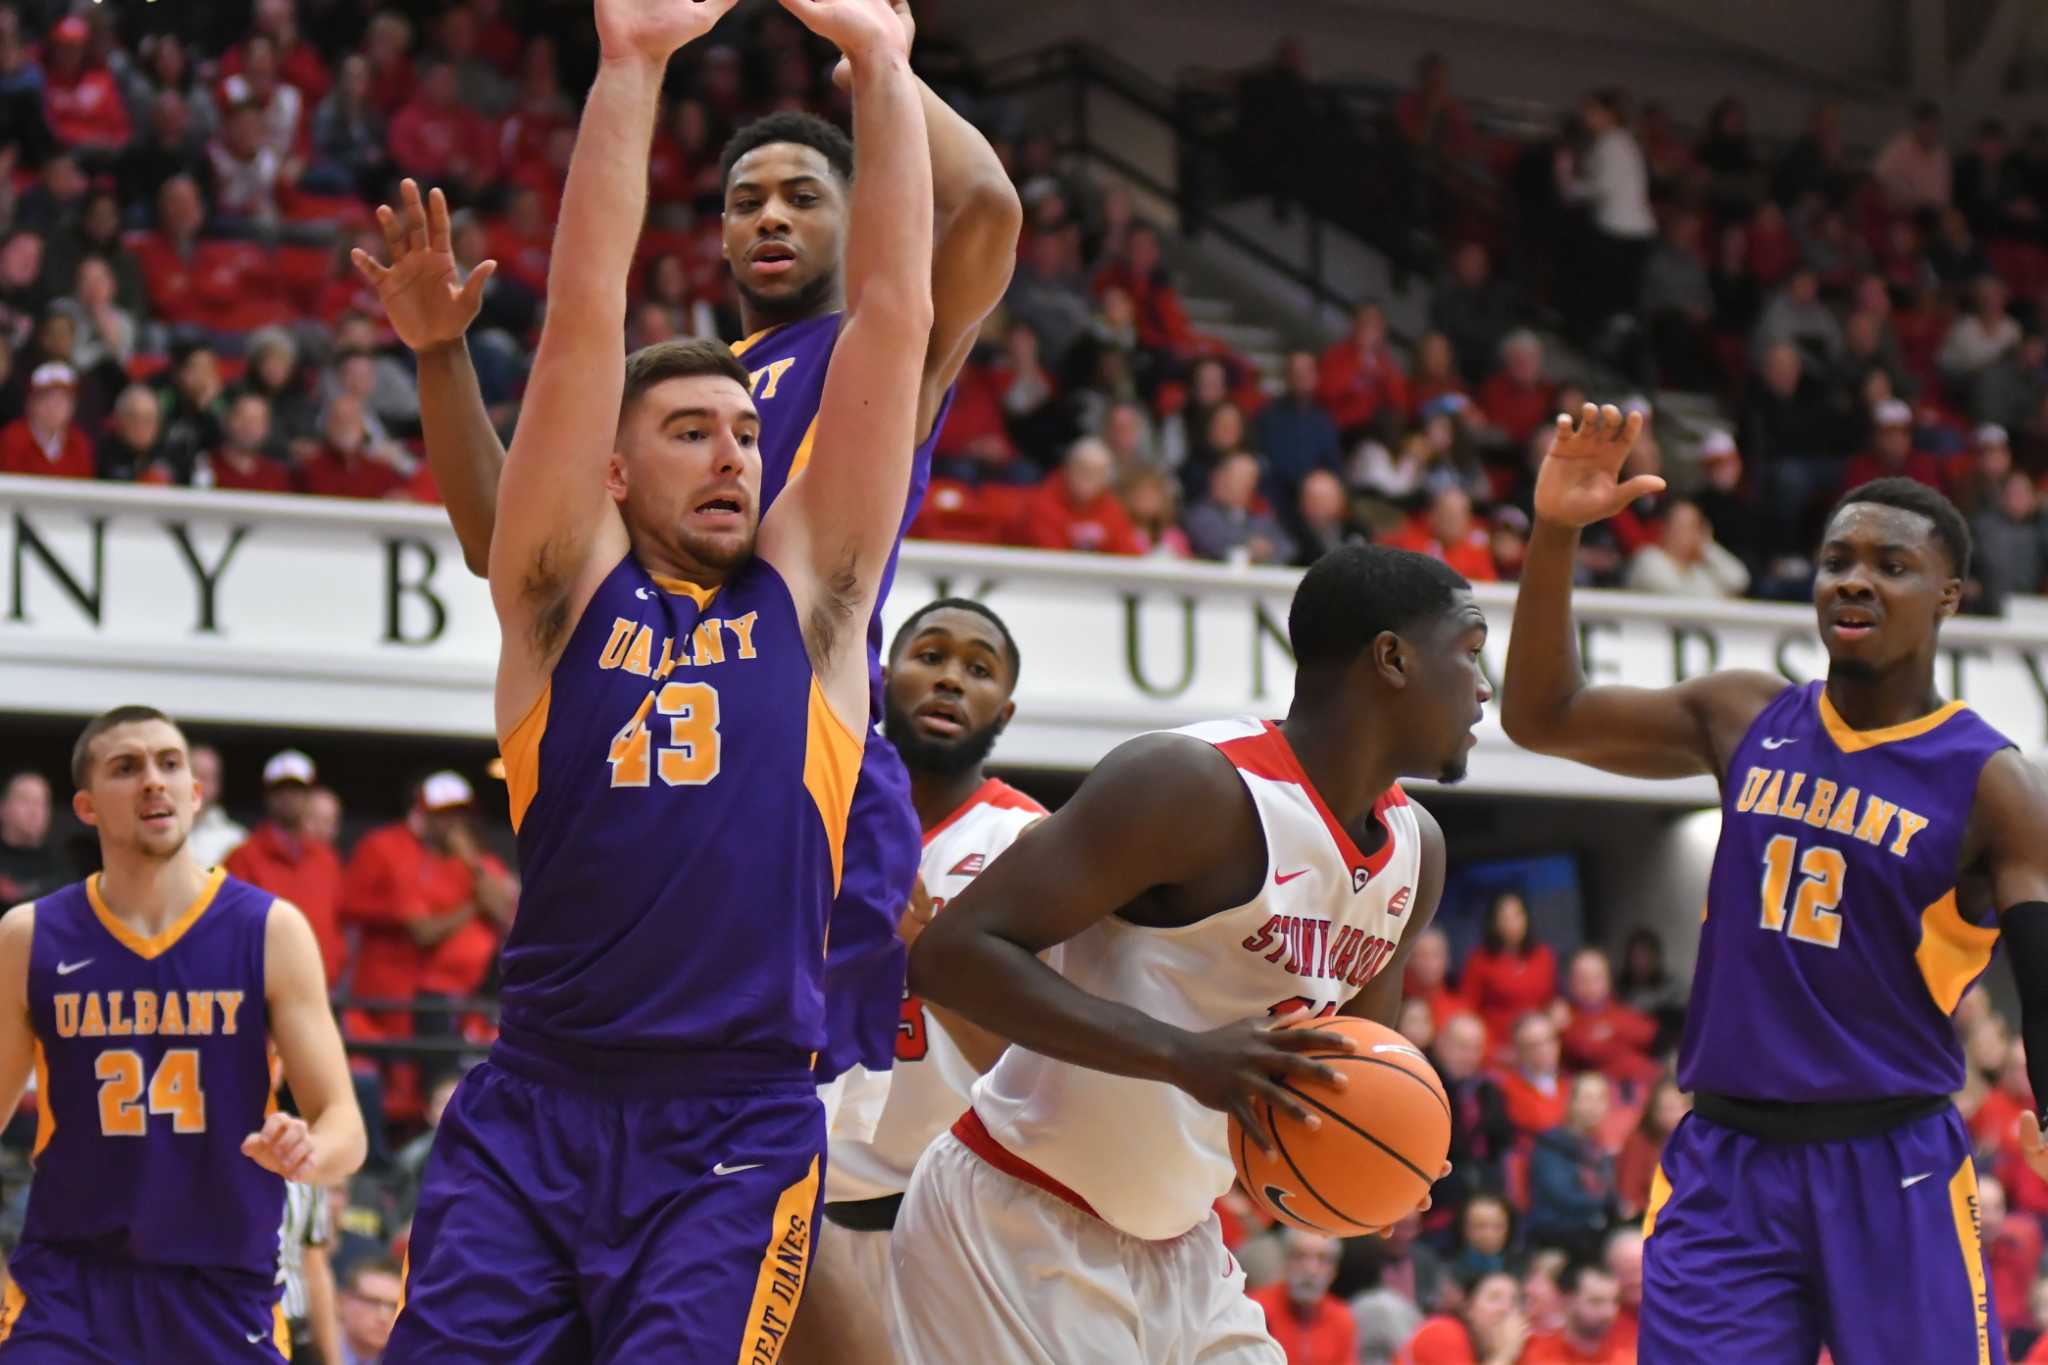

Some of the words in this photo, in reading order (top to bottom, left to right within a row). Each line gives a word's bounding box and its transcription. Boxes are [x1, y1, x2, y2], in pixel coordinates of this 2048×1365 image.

[607, 681, 721, 788] 43
[1736, 766, 1930, 858] UALBANY
[1759, 833, 1848, 950] 12
[1242, 914, 1332, 978] STONY
[53, 990, 244, 1038] UALBANY
[94, 1048, 206, 1136] 24
[771, 1214, 809, 1307] DANES
